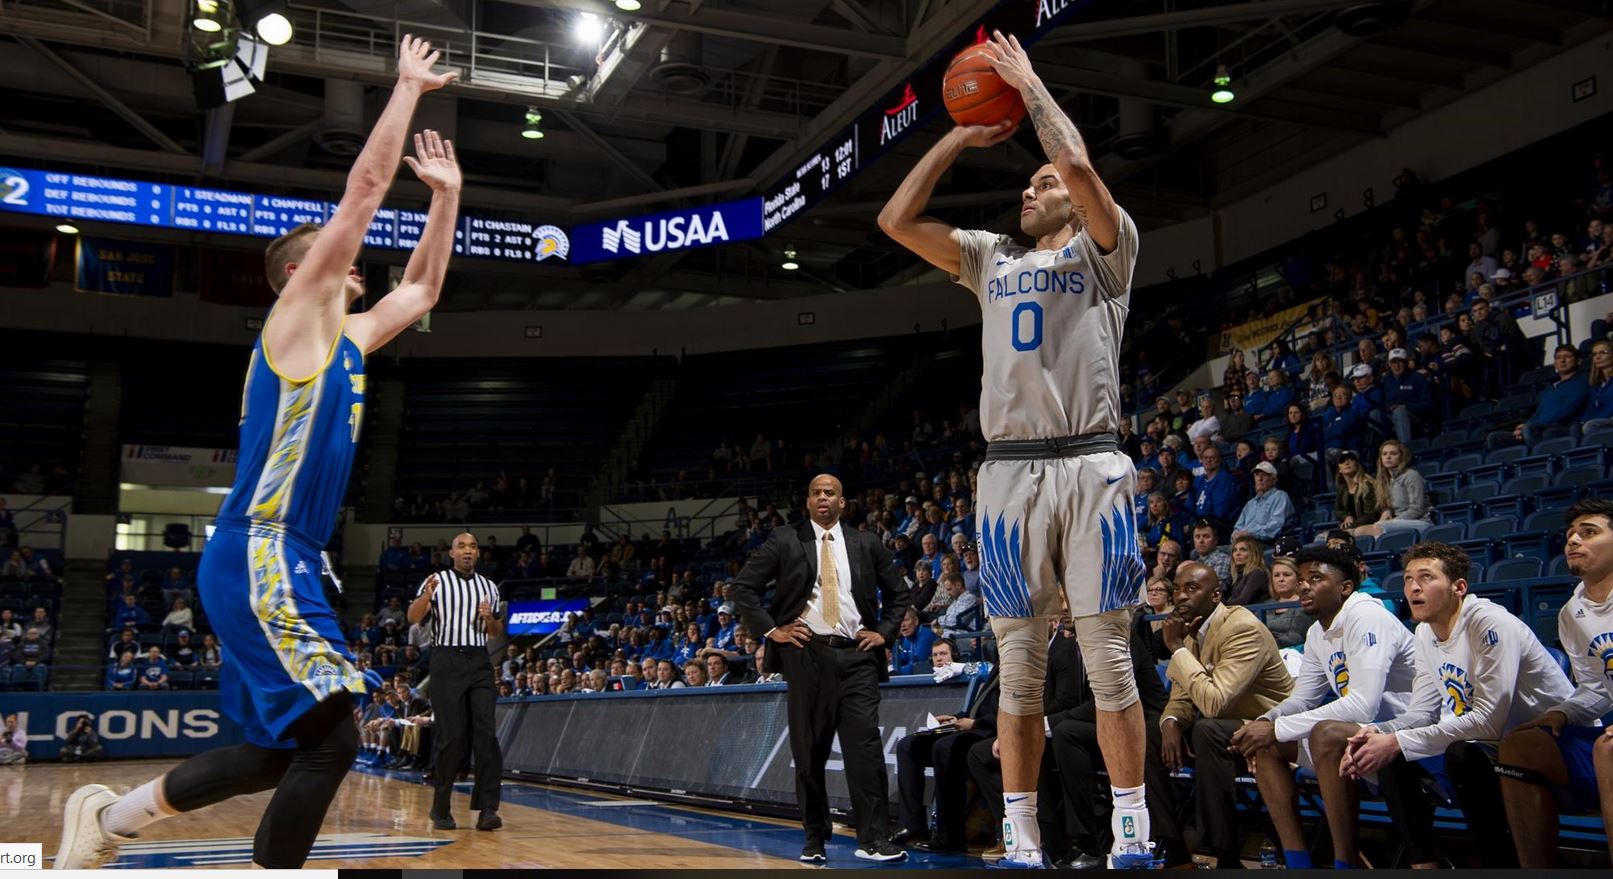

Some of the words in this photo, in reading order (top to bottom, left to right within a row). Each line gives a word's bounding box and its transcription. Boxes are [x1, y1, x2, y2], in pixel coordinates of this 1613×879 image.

[880, 100, 919, 146] ALEUT
[3, 176, 29, 206] 2
[45, 173, 69, 184] OFF
[72, 175, 137, 192] REBOUNDS
[152, 184, 161, 195] 0
[44, 188, 69, 199] DEF
[71, 191, 137, 207] REBOUNDS
[151, 199, 161, 209] 0
[177, 202, 199, 212] PTS
[217, 206, 238, 216] AST
[45, 203, 69, 215] TOT
[70, 206, 136, 221] REBOUNDS
[150, 214, 160, 224] 0
[255, 210, 276, 220] PTS
[400, 225, 420, 235] PTS
[472, 219, 484, 229] 41
[485, 220, 532, 234] CHASTAIN
[644, 210, 729, 251] USAA
[471, 232, 490, 242] PTS
[504, 235, 523, 245] AST
[107, 272, 144, 284] STATE
[988, 268, 1085, 304] FALCONS
[1537, 295, 1553, 310] L14
[1011, 301, 1043, 352] 0
